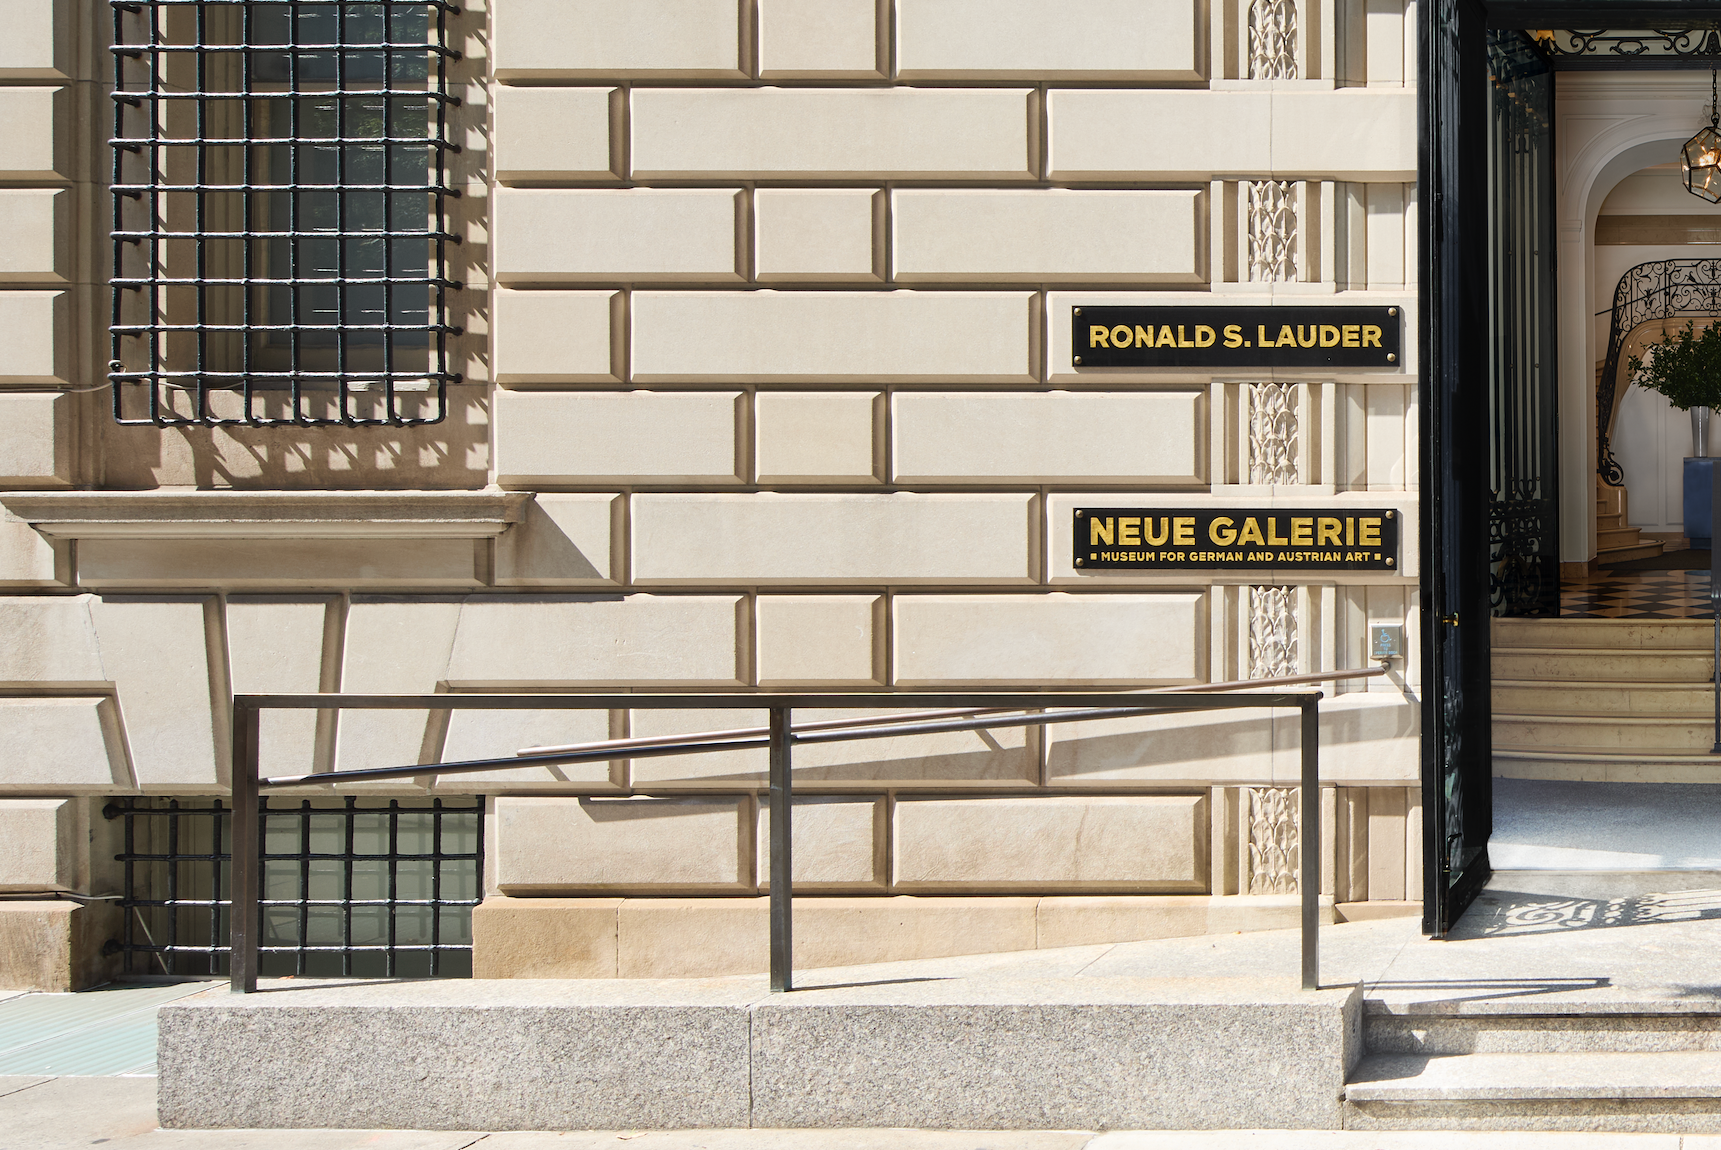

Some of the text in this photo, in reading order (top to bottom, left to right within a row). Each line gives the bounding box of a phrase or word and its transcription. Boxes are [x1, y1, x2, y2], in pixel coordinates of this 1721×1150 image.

[1090, 325, 1382, 348] RONALD S. LAUDER
[1091, 517, 1381, 546] NEUE GALERIE
[1101, 552, 1370, 562] MUSEUM FOR GERMAN AND AUSTRIAN ART
